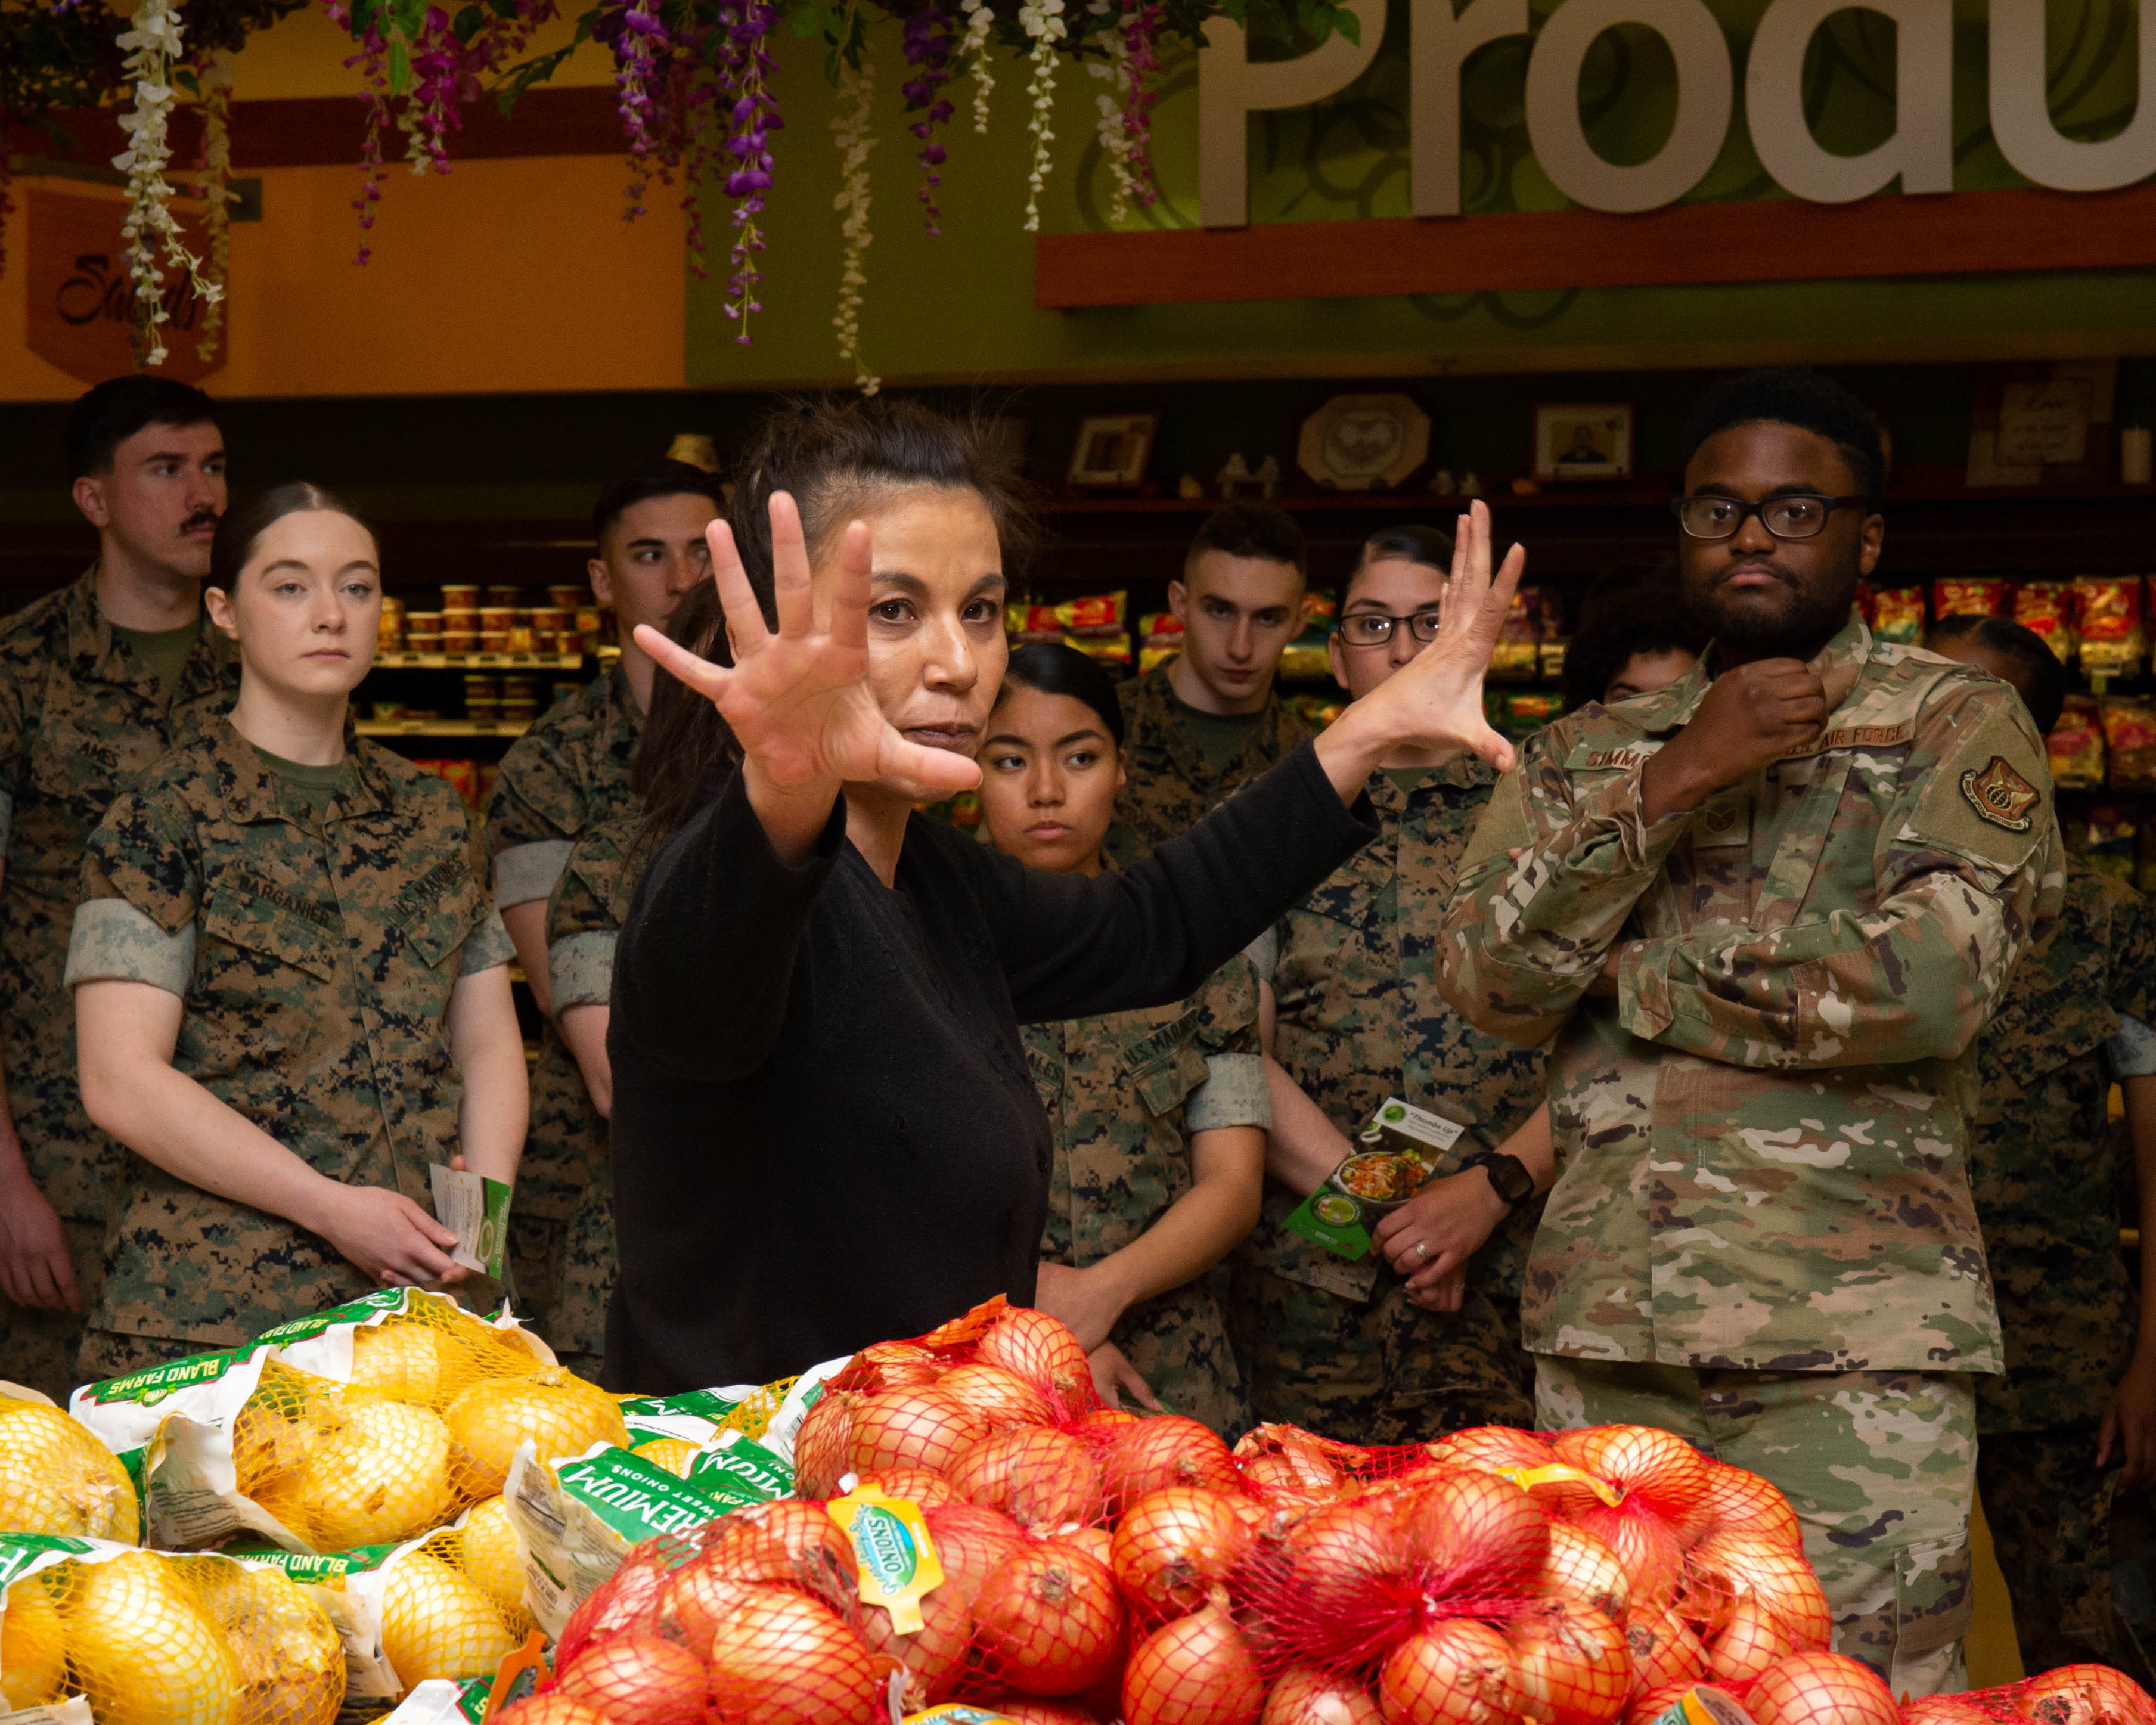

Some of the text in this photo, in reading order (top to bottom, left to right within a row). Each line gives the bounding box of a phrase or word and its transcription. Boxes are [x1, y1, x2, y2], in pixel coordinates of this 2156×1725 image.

[1820, 724, 1846, 749] AIR
[1853, 723, 1906, 743] FORCE
[1586, 750, 1641, 767] SIMM
[414, 858, 465, 900] MARINES
[240, 874, 330, 926] BARGANIER
[287, 1318, 330, 1335] BLAND
[108, 1358, 220, 1395] BLAND FARMS
[612, 1464, 669, 1492] ONIONS
[697, 1452, 796, 1501] MIUM
[868, 1519, 902, 1573] ONIONS
[289, 1555, 349, 1573] BLAND
